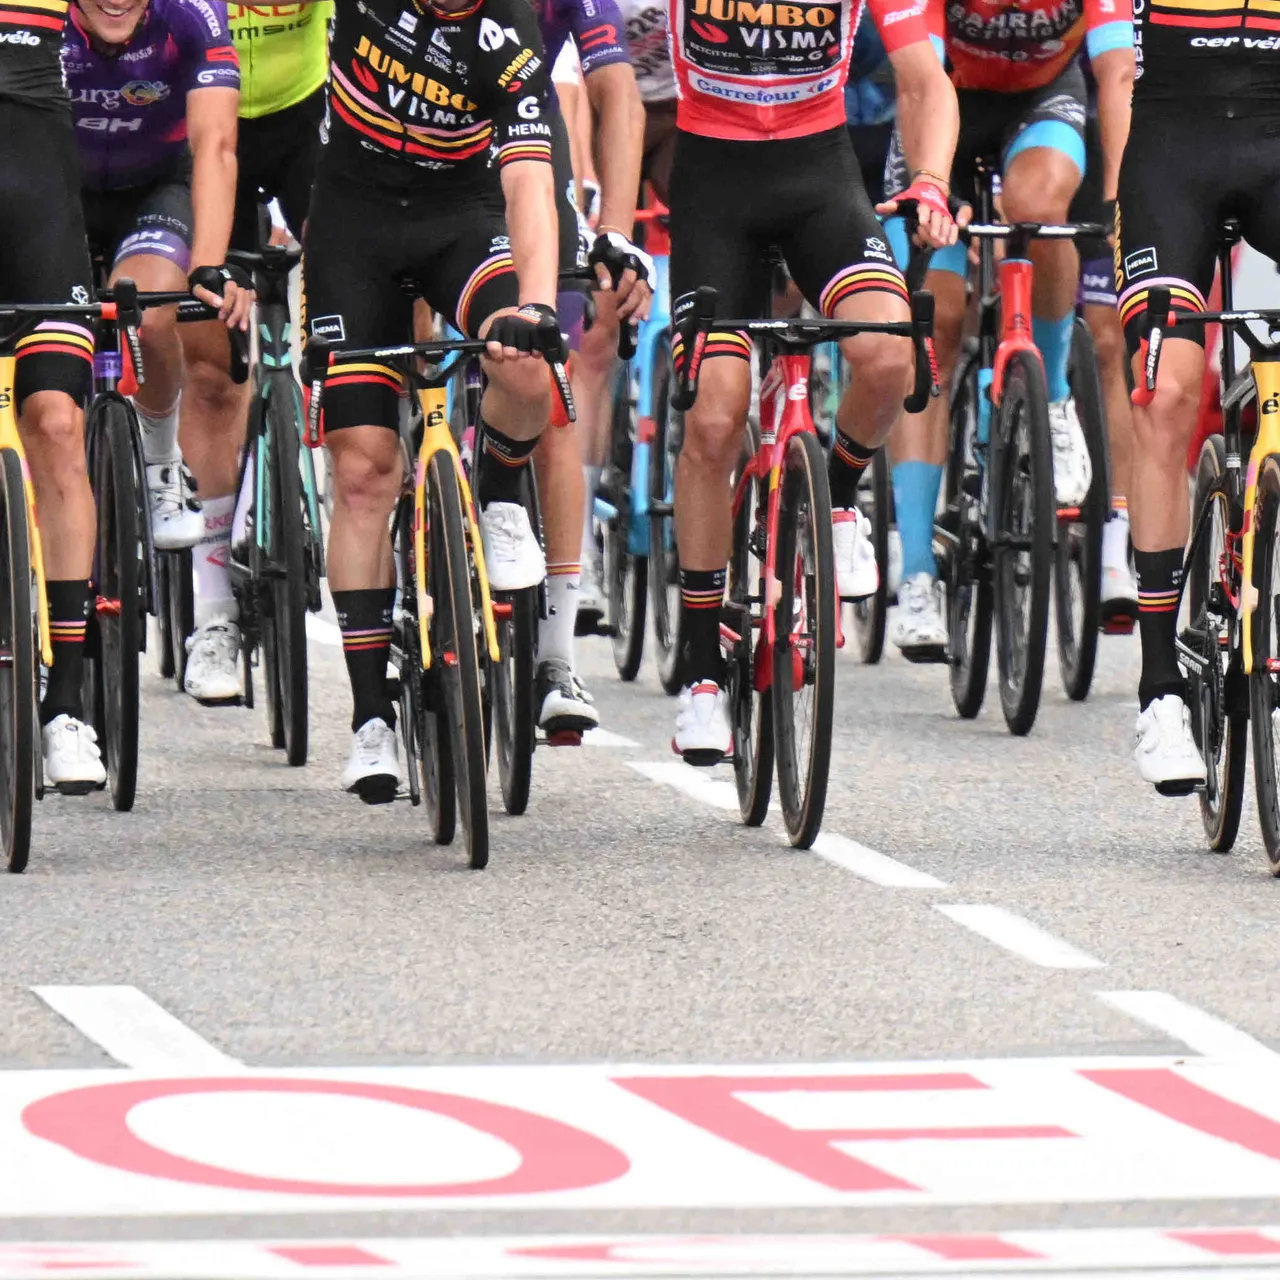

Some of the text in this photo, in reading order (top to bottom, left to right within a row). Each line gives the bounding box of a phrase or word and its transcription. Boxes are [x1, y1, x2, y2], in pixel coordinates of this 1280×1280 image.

[739, 26, 836, 49] VISMA
[353, 35, 479, 110] JUMBO
[497, 48, 533, 88] JUMBO
[518, 57, 542, 80] VISMA
[697, 78, 800, 103] Carrefour
[387, 84, 474, 125] VISMA
[508, 122, 552, 137] HEMA
[1127, 254, 1154, 271] HEMA
[314, 323, 340, 335] HEMA
[1179, 651, 1203, 676] SRAM
